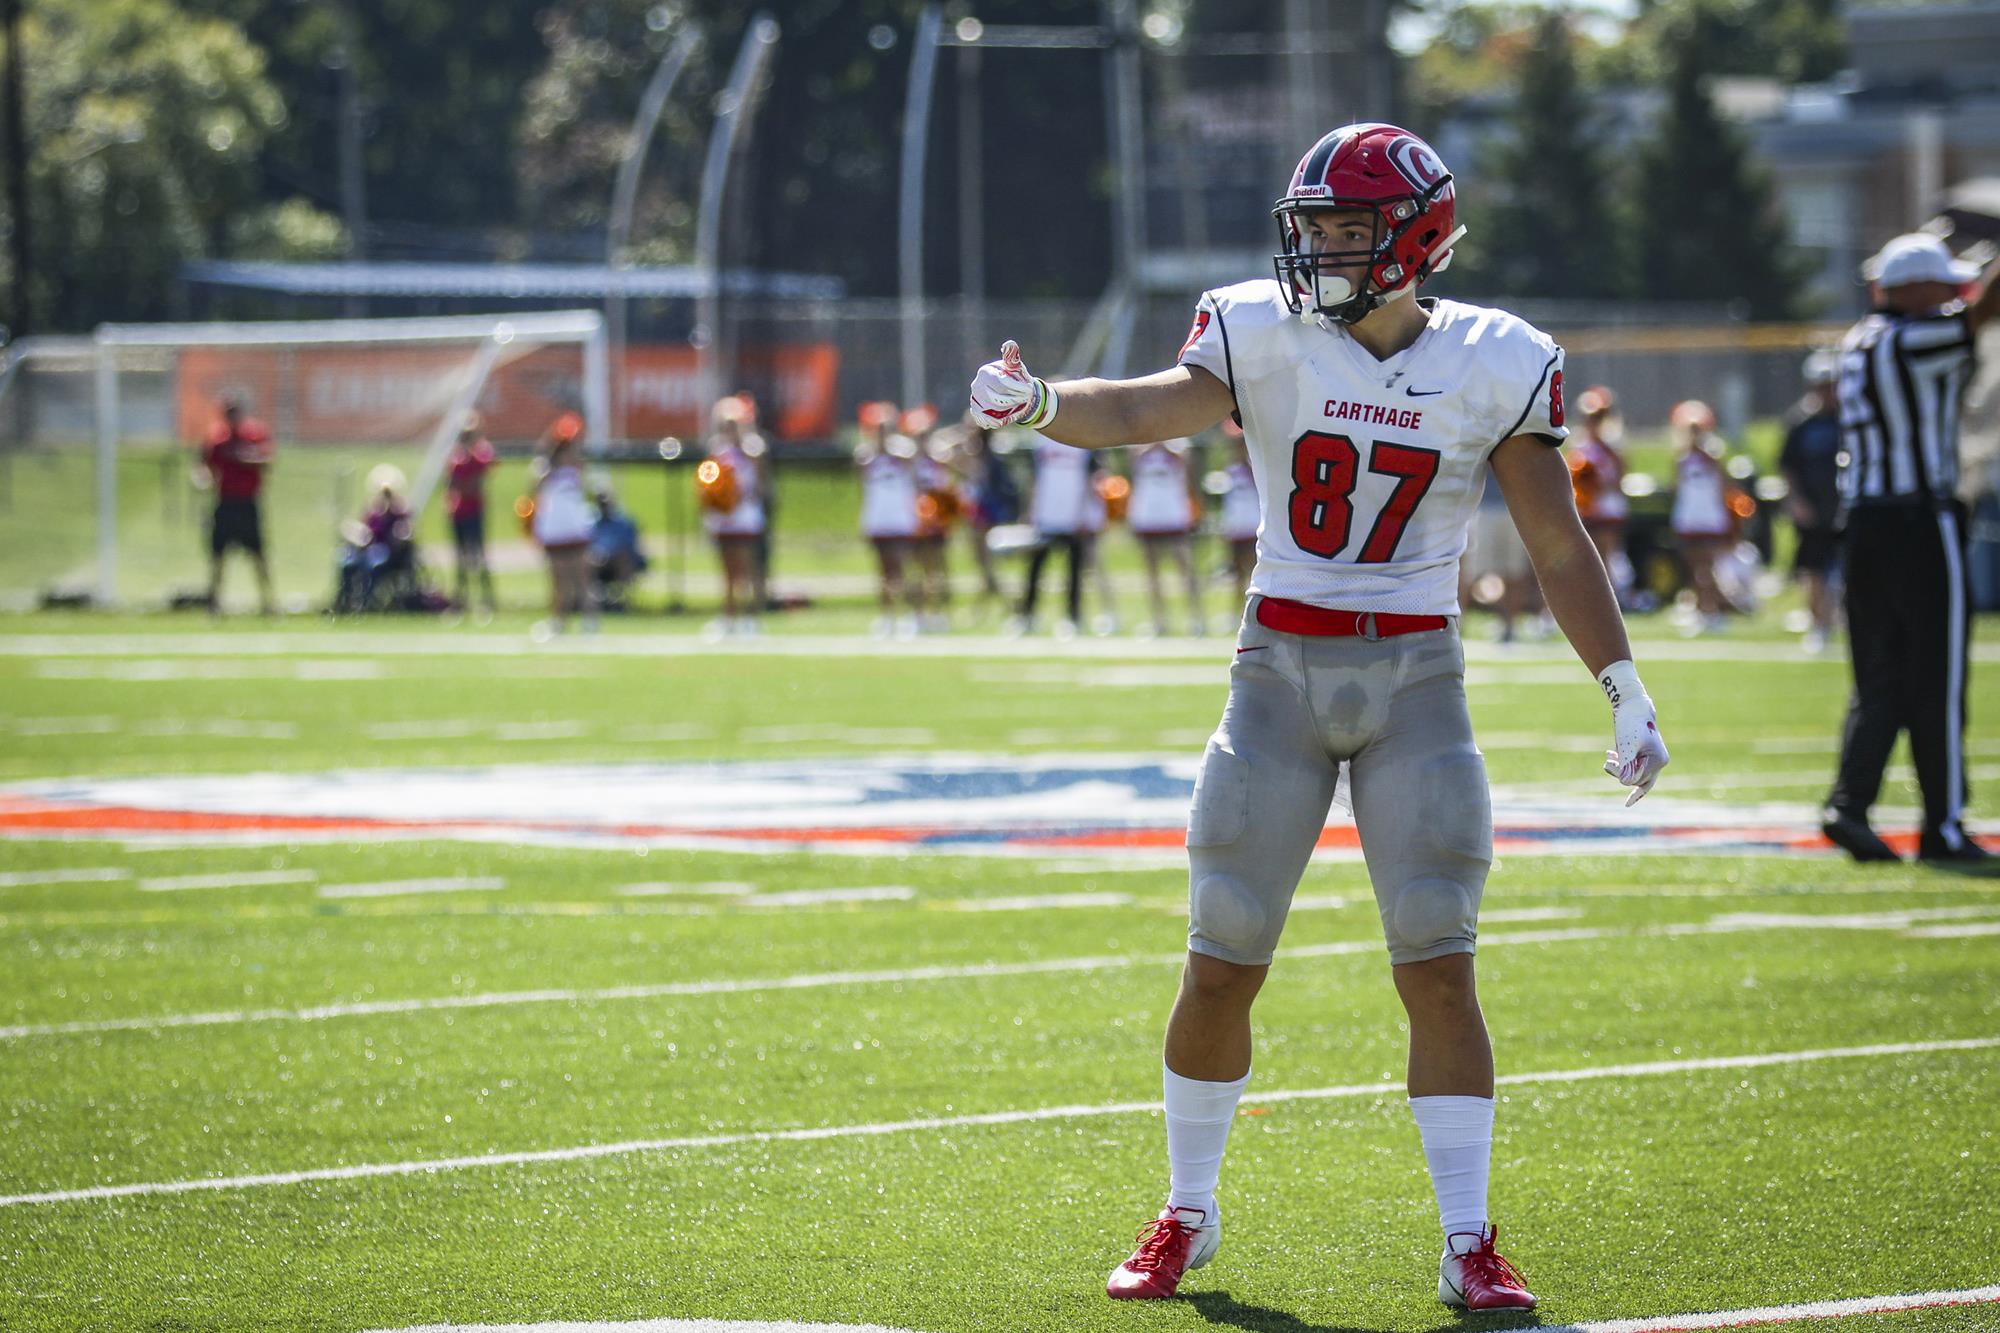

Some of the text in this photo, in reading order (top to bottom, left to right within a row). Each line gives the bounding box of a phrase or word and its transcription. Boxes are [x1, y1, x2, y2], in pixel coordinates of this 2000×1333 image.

[1293, 187, 1326, 197] Riddell
[1323, 399, 1423, 430] CARTHAGE
[1288, 429, 1441, 563] 87
